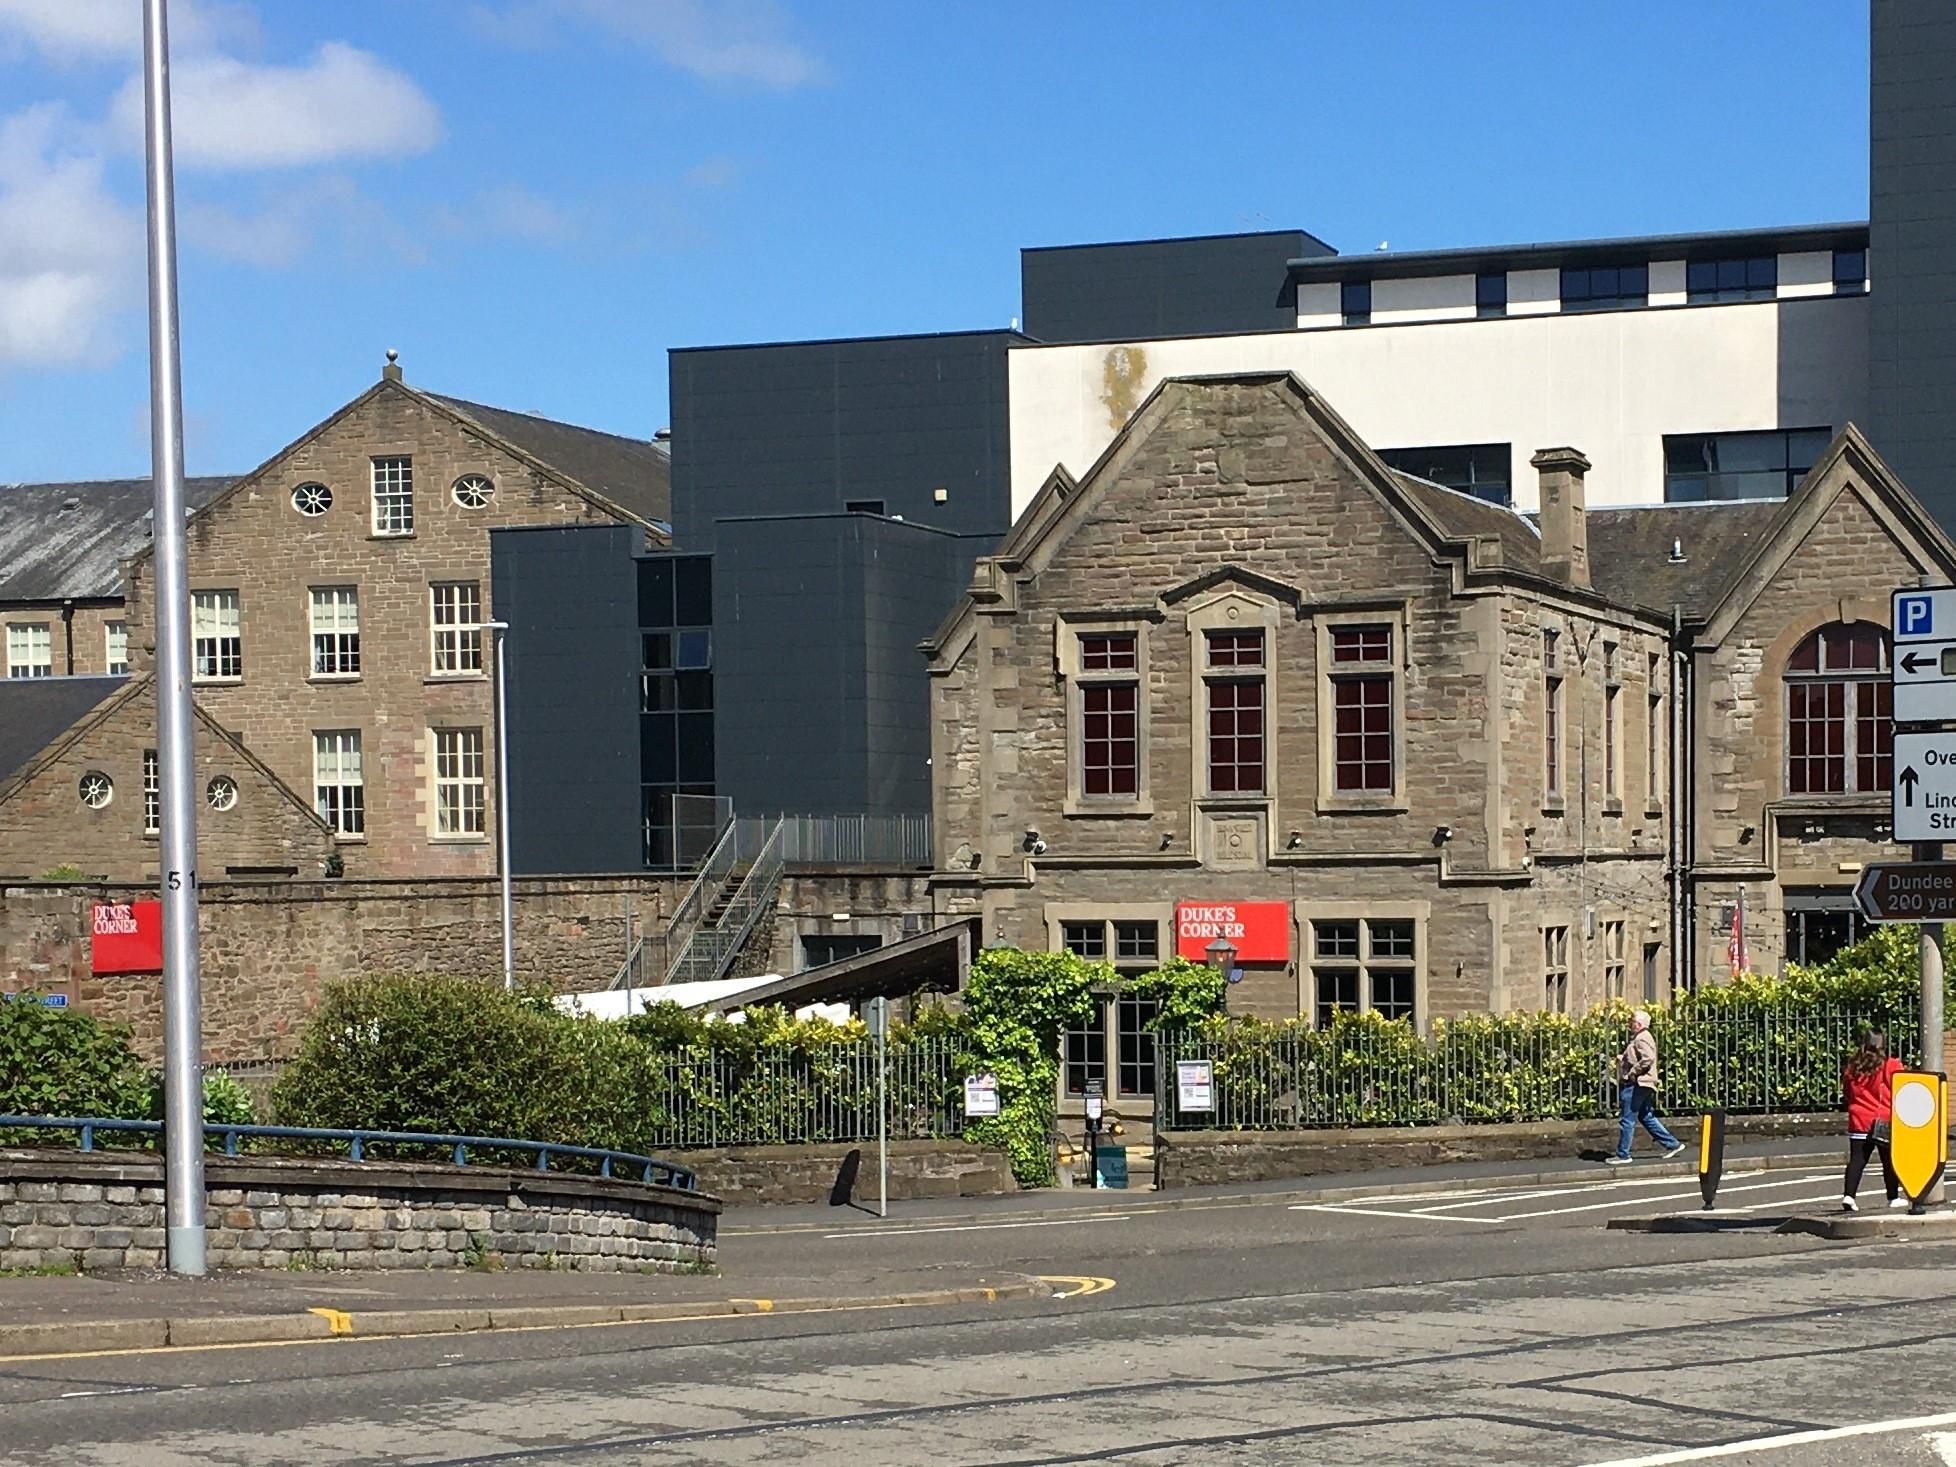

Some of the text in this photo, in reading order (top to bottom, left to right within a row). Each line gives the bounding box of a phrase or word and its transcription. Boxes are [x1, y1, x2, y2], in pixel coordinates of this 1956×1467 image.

[1907, 601, 1927, 632] P
[1924, 749, 1956, 766] Ove
[168, 870, 196, 890] 51
[1889, 873, 1953, 890] Dundee
[1888, 894, 1923, 910] 200
[1180, 906, 1236, 922] DUKE'S
[94, 919, 138, 934] CORNER
[1180, 922, 1245, 938] CORNER
